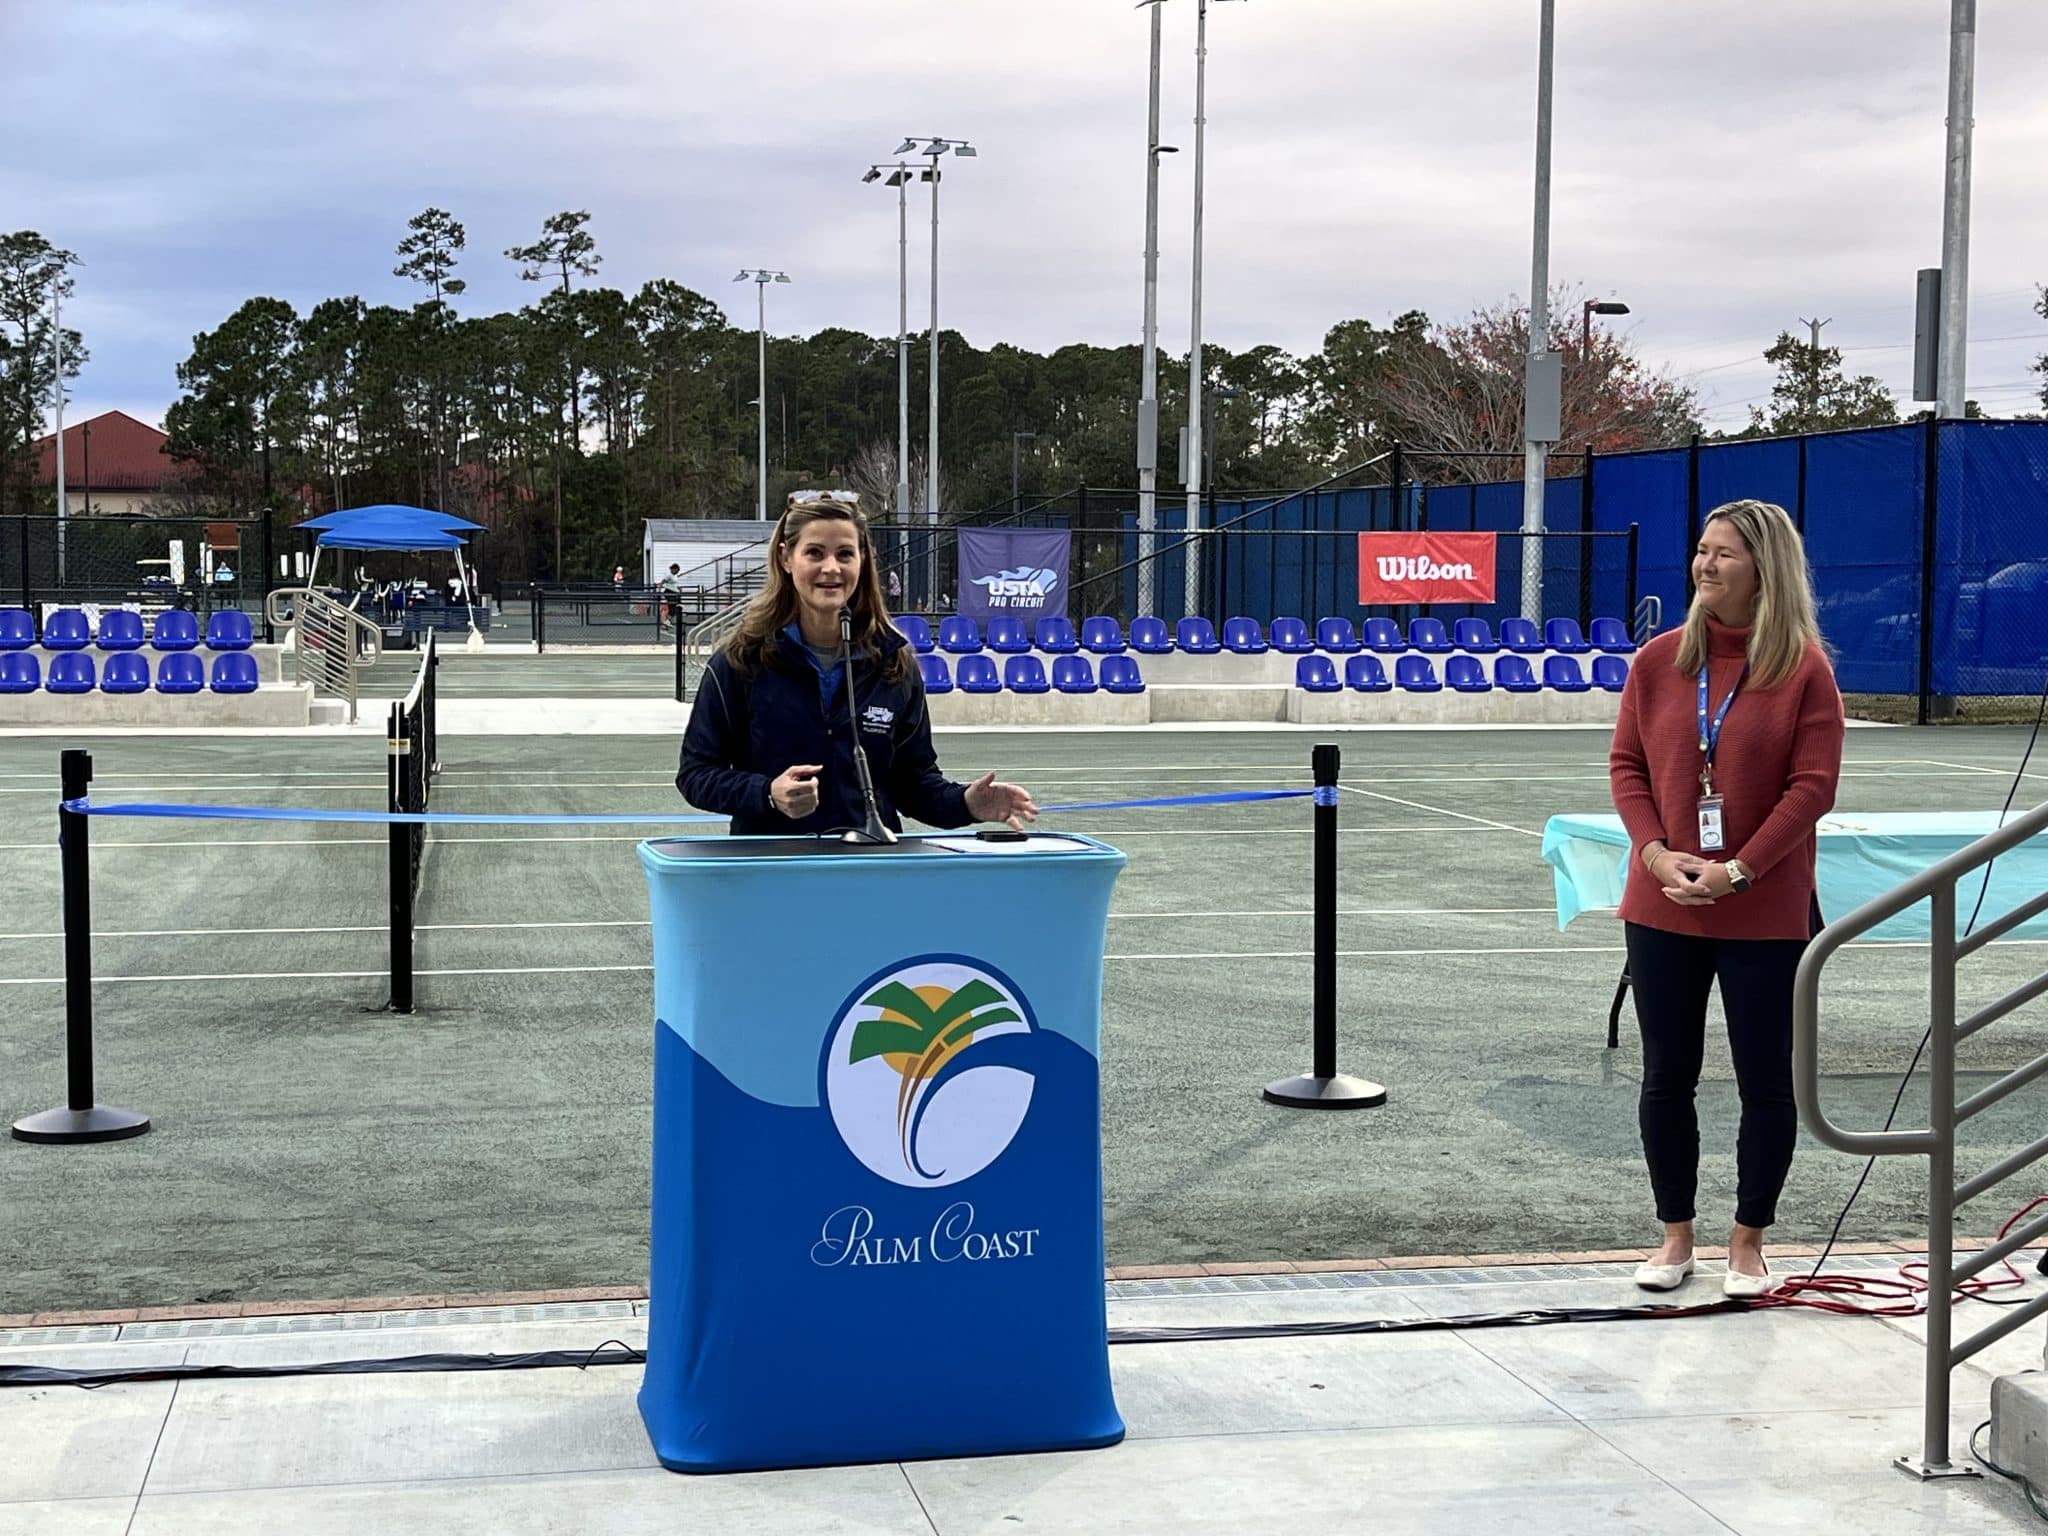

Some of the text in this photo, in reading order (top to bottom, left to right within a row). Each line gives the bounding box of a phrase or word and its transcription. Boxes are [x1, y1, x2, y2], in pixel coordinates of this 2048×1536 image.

[1376, 555, 1475, 581] Wilson
[988, 579, 1045, 596] USTA
[988, 596, 1045, 608] PRO CIRCUIT
[811, 1201, 1040, 1267] PALM COAST
